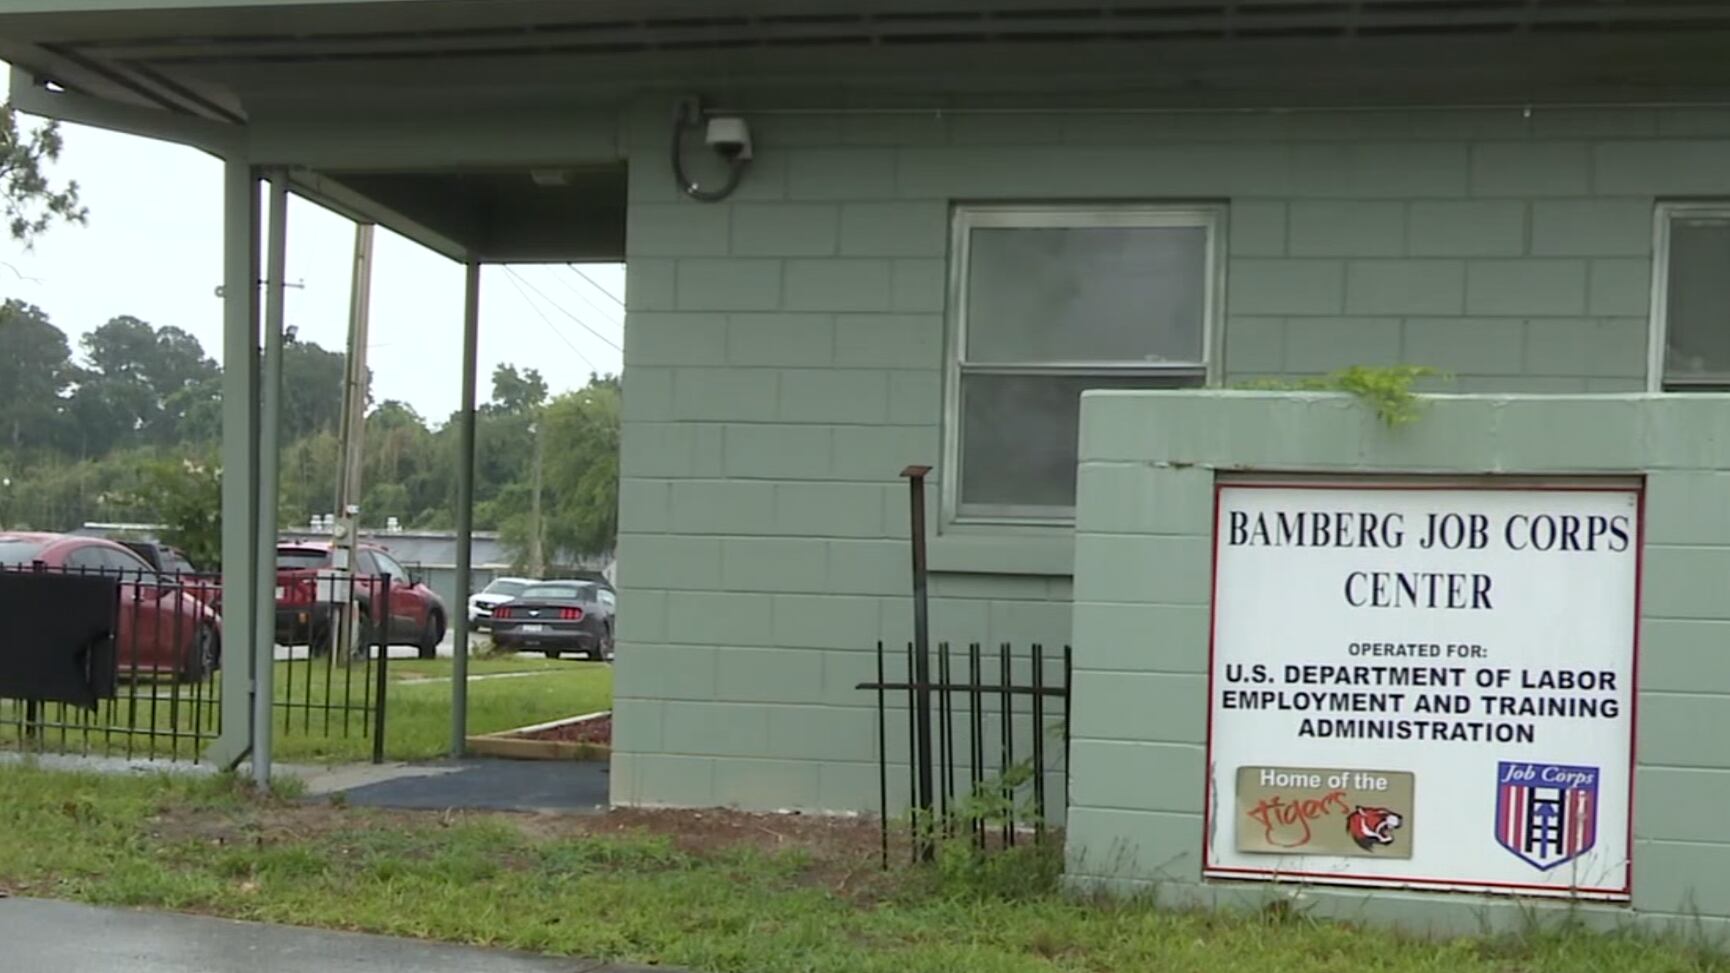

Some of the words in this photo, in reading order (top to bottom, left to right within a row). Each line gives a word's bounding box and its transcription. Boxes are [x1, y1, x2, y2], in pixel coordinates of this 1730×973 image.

[1228, 511, 1404, 548] BAMBERG
[1420, 513, 1489, 550] JOB
[1505, 514, 1630, 552] CORPS
[1344, 571, 1493, 610] CENTER
[1348, 643, 1441, 658] OPERATED
[1446, 644, 1487, 659] FOR:
[1225, 664, 1274, 684] U.S.
[1284, 665, 1466, 688] DEPARTMENT
[1476, 668, 1511, 688] OF
[1521, 670, 1616, 691] LABOR
[1222, 691, 1404, 713] EMPLOYMENT
[1414, 694, 1470, 714] AND
[1481, 696, 1619, 718] TRAINING
[1297, 719, 1535, 743] ADMINISTRATION
[1260, 769, 1321, 789] Home
[1327, 771, 1351, 789] of
[1354, 772, 1388, 791] the
[1502, 765, 1536, 784] Job
[1541, 767, 1595, 788] Corps
